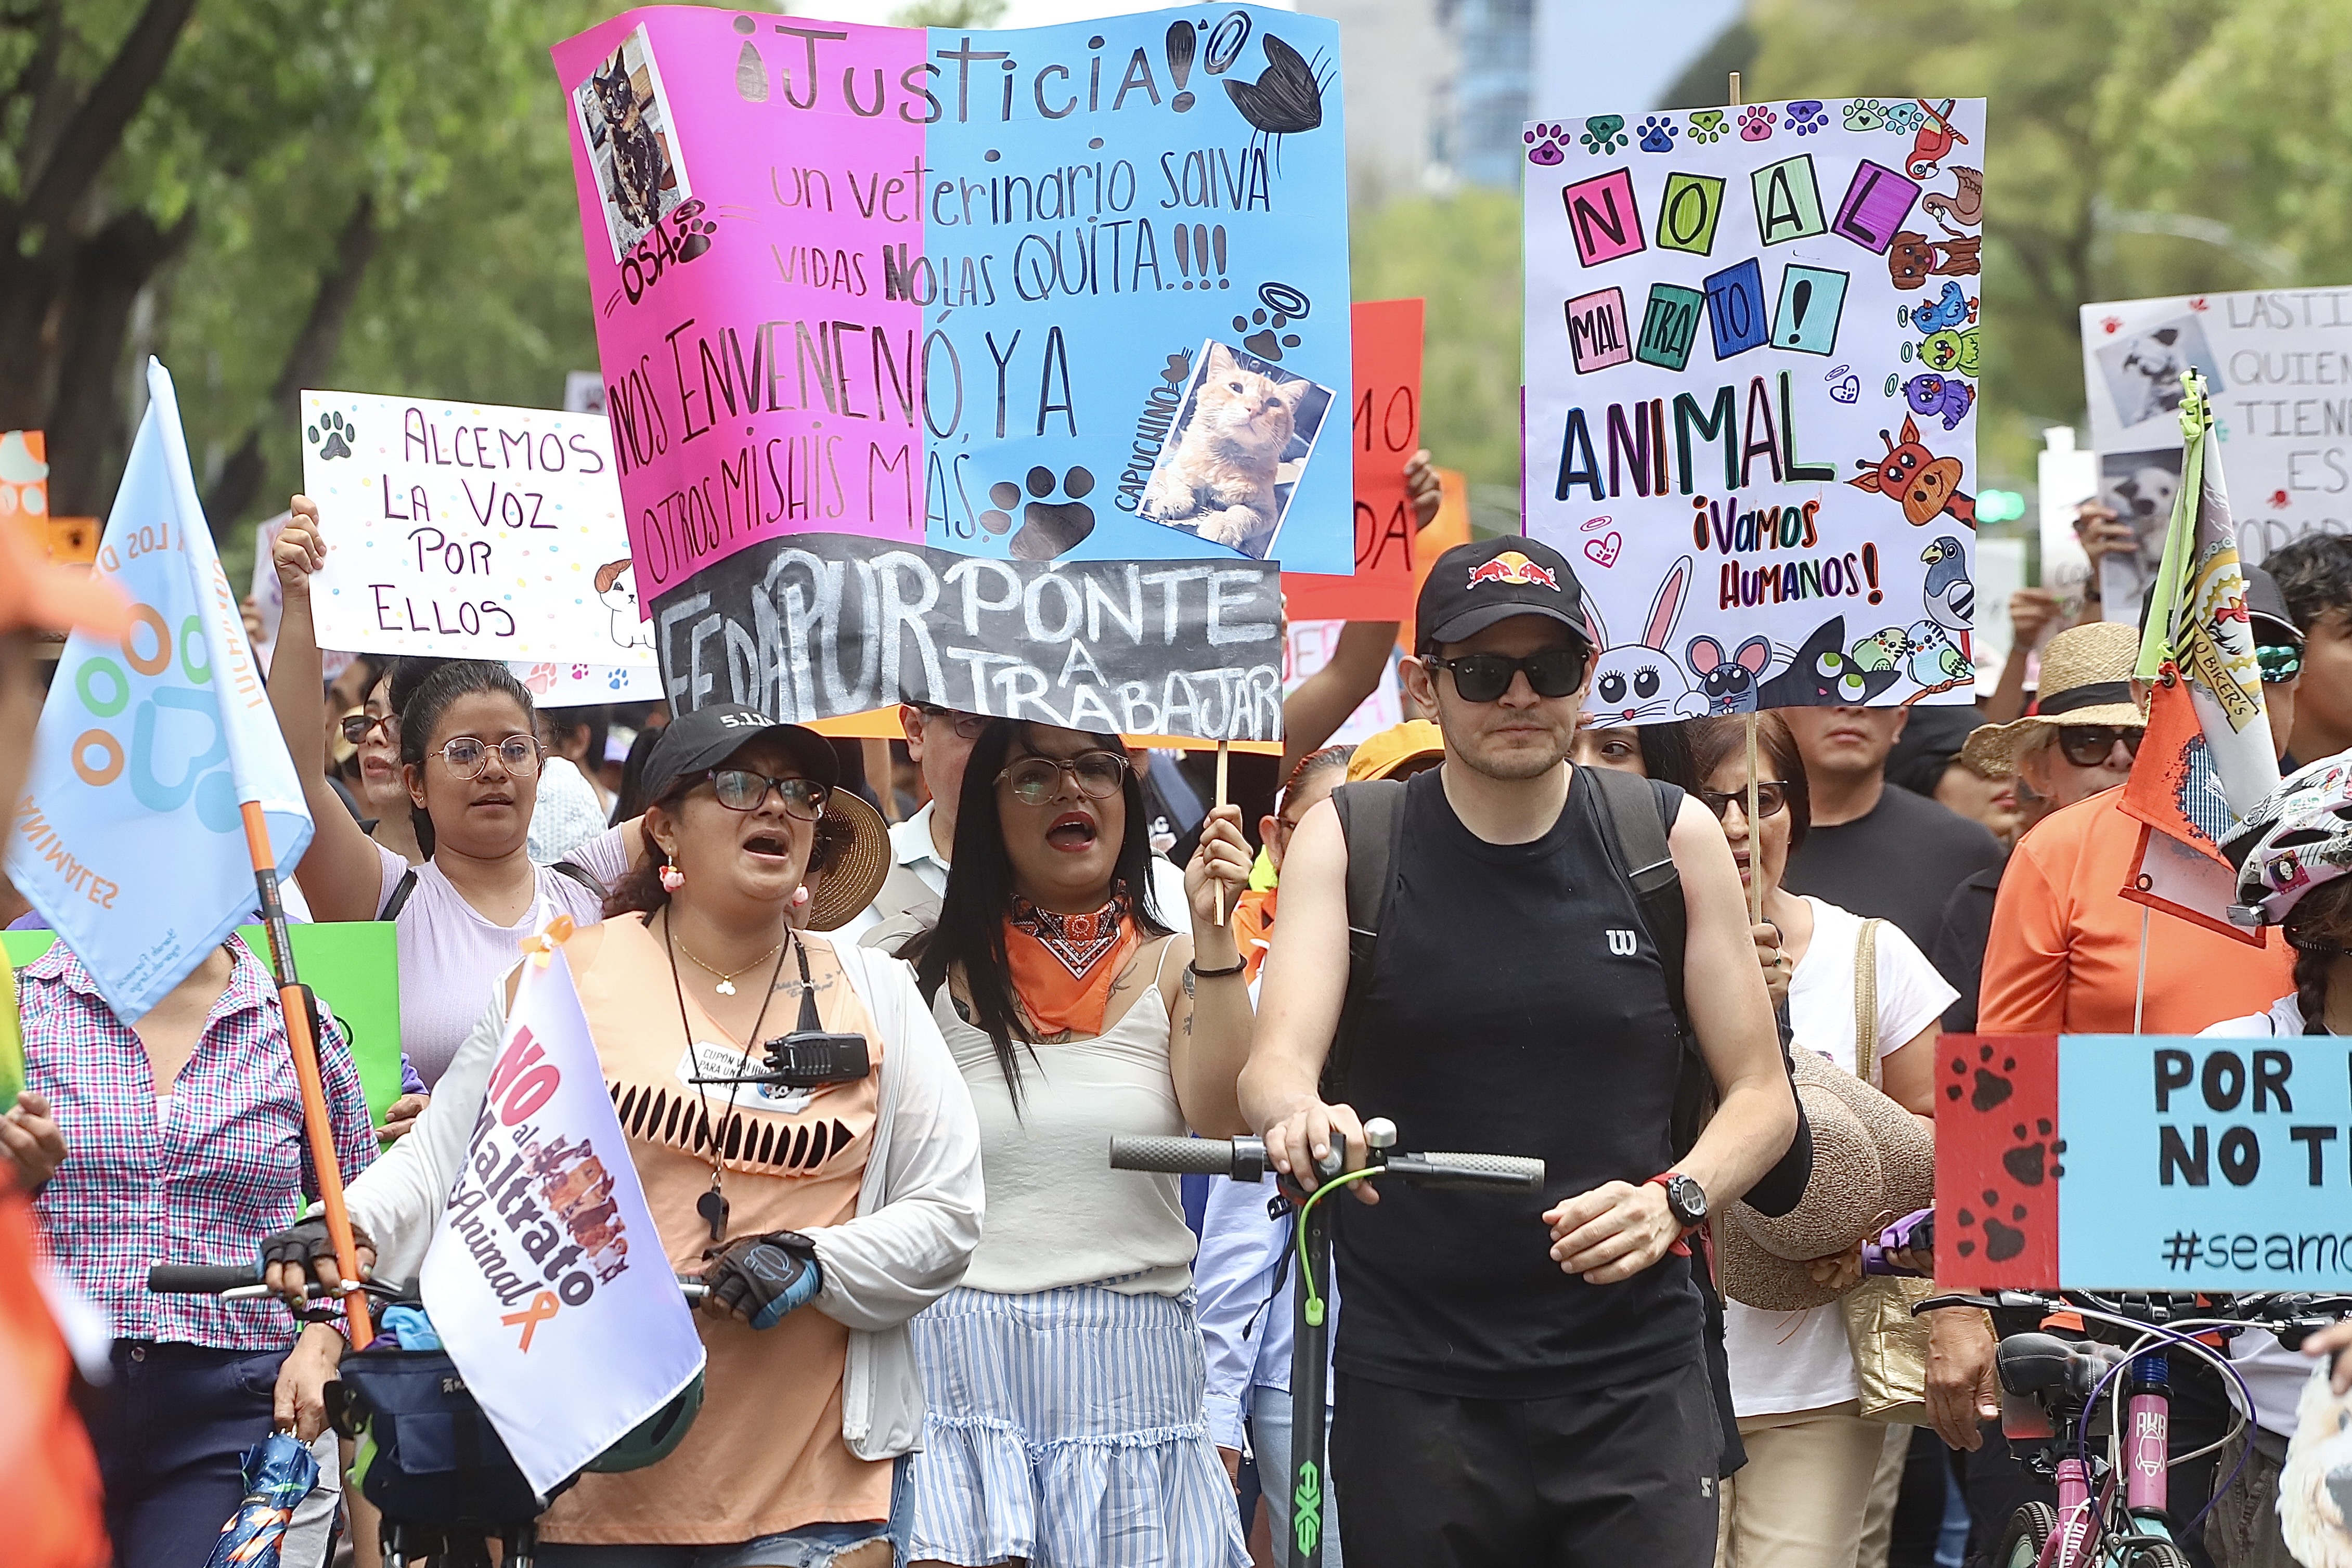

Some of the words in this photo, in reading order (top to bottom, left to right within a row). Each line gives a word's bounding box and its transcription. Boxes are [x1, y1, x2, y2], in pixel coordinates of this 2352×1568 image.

[847, 137, 1135, 226] veterinario
[1573, 182, 1707, 256] NO
[1766, 166, 1883, 244] AL
[622, 222, 676, 305] OSA
[770, 244, 867, 296] VIDAS
[405, 407, 604, 474] ALCEMOS
[609, 354, 668, 476] NOS
[1115, 387, 1181, 512] CAPUCHINO
[1555, 370, 1836, 501] ANIMAL
[2235, 398, 2352, 436] TIEN
[383, 474, 430, 521] LA
[461, 478, 558, 529] VOZ
[643, 477, 721, 585] OTROS
[408, 527, 492, 576] POR
[368, 585, 516, 637] ELLOS
[947, 645, 1281, 742] TRABAJAR
[489, 1025, 560, 1127] NO
[2154, 1049, 2293, 1113] POR
[513, 1124, 539, 1148] al
[2160, 1126, 2260, 1187] NO
[448, 1181, 545, 1306] Animal
